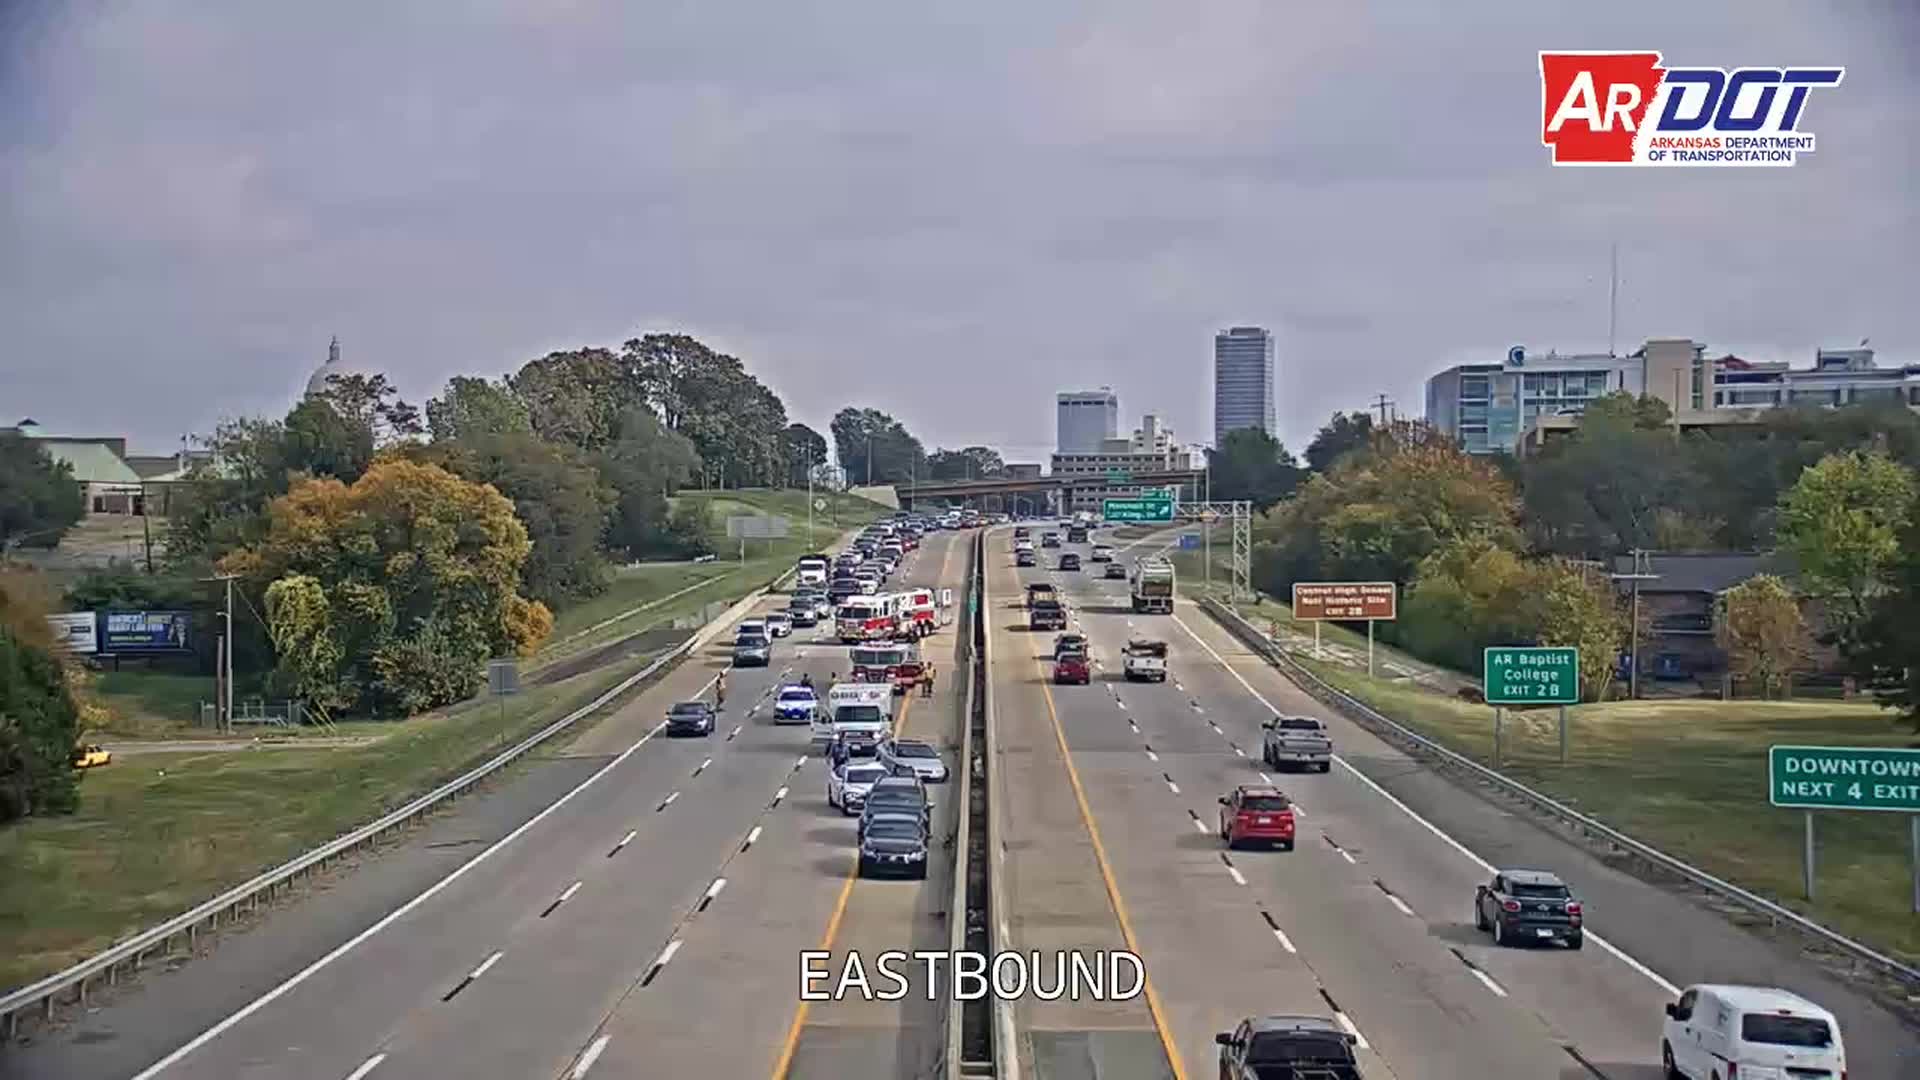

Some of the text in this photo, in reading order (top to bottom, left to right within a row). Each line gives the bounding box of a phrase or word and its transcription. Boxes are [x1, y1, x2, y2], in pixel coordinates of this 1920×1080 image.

[1494, 653, 1570, 667] AR Baptist
[1504, 669, 1559, 683] College
[1503, 684, 1560, 697] EXIT 2B
[1782, 781, 1834, 797] NEXT
[1847, 781, 1863, 800] 4
